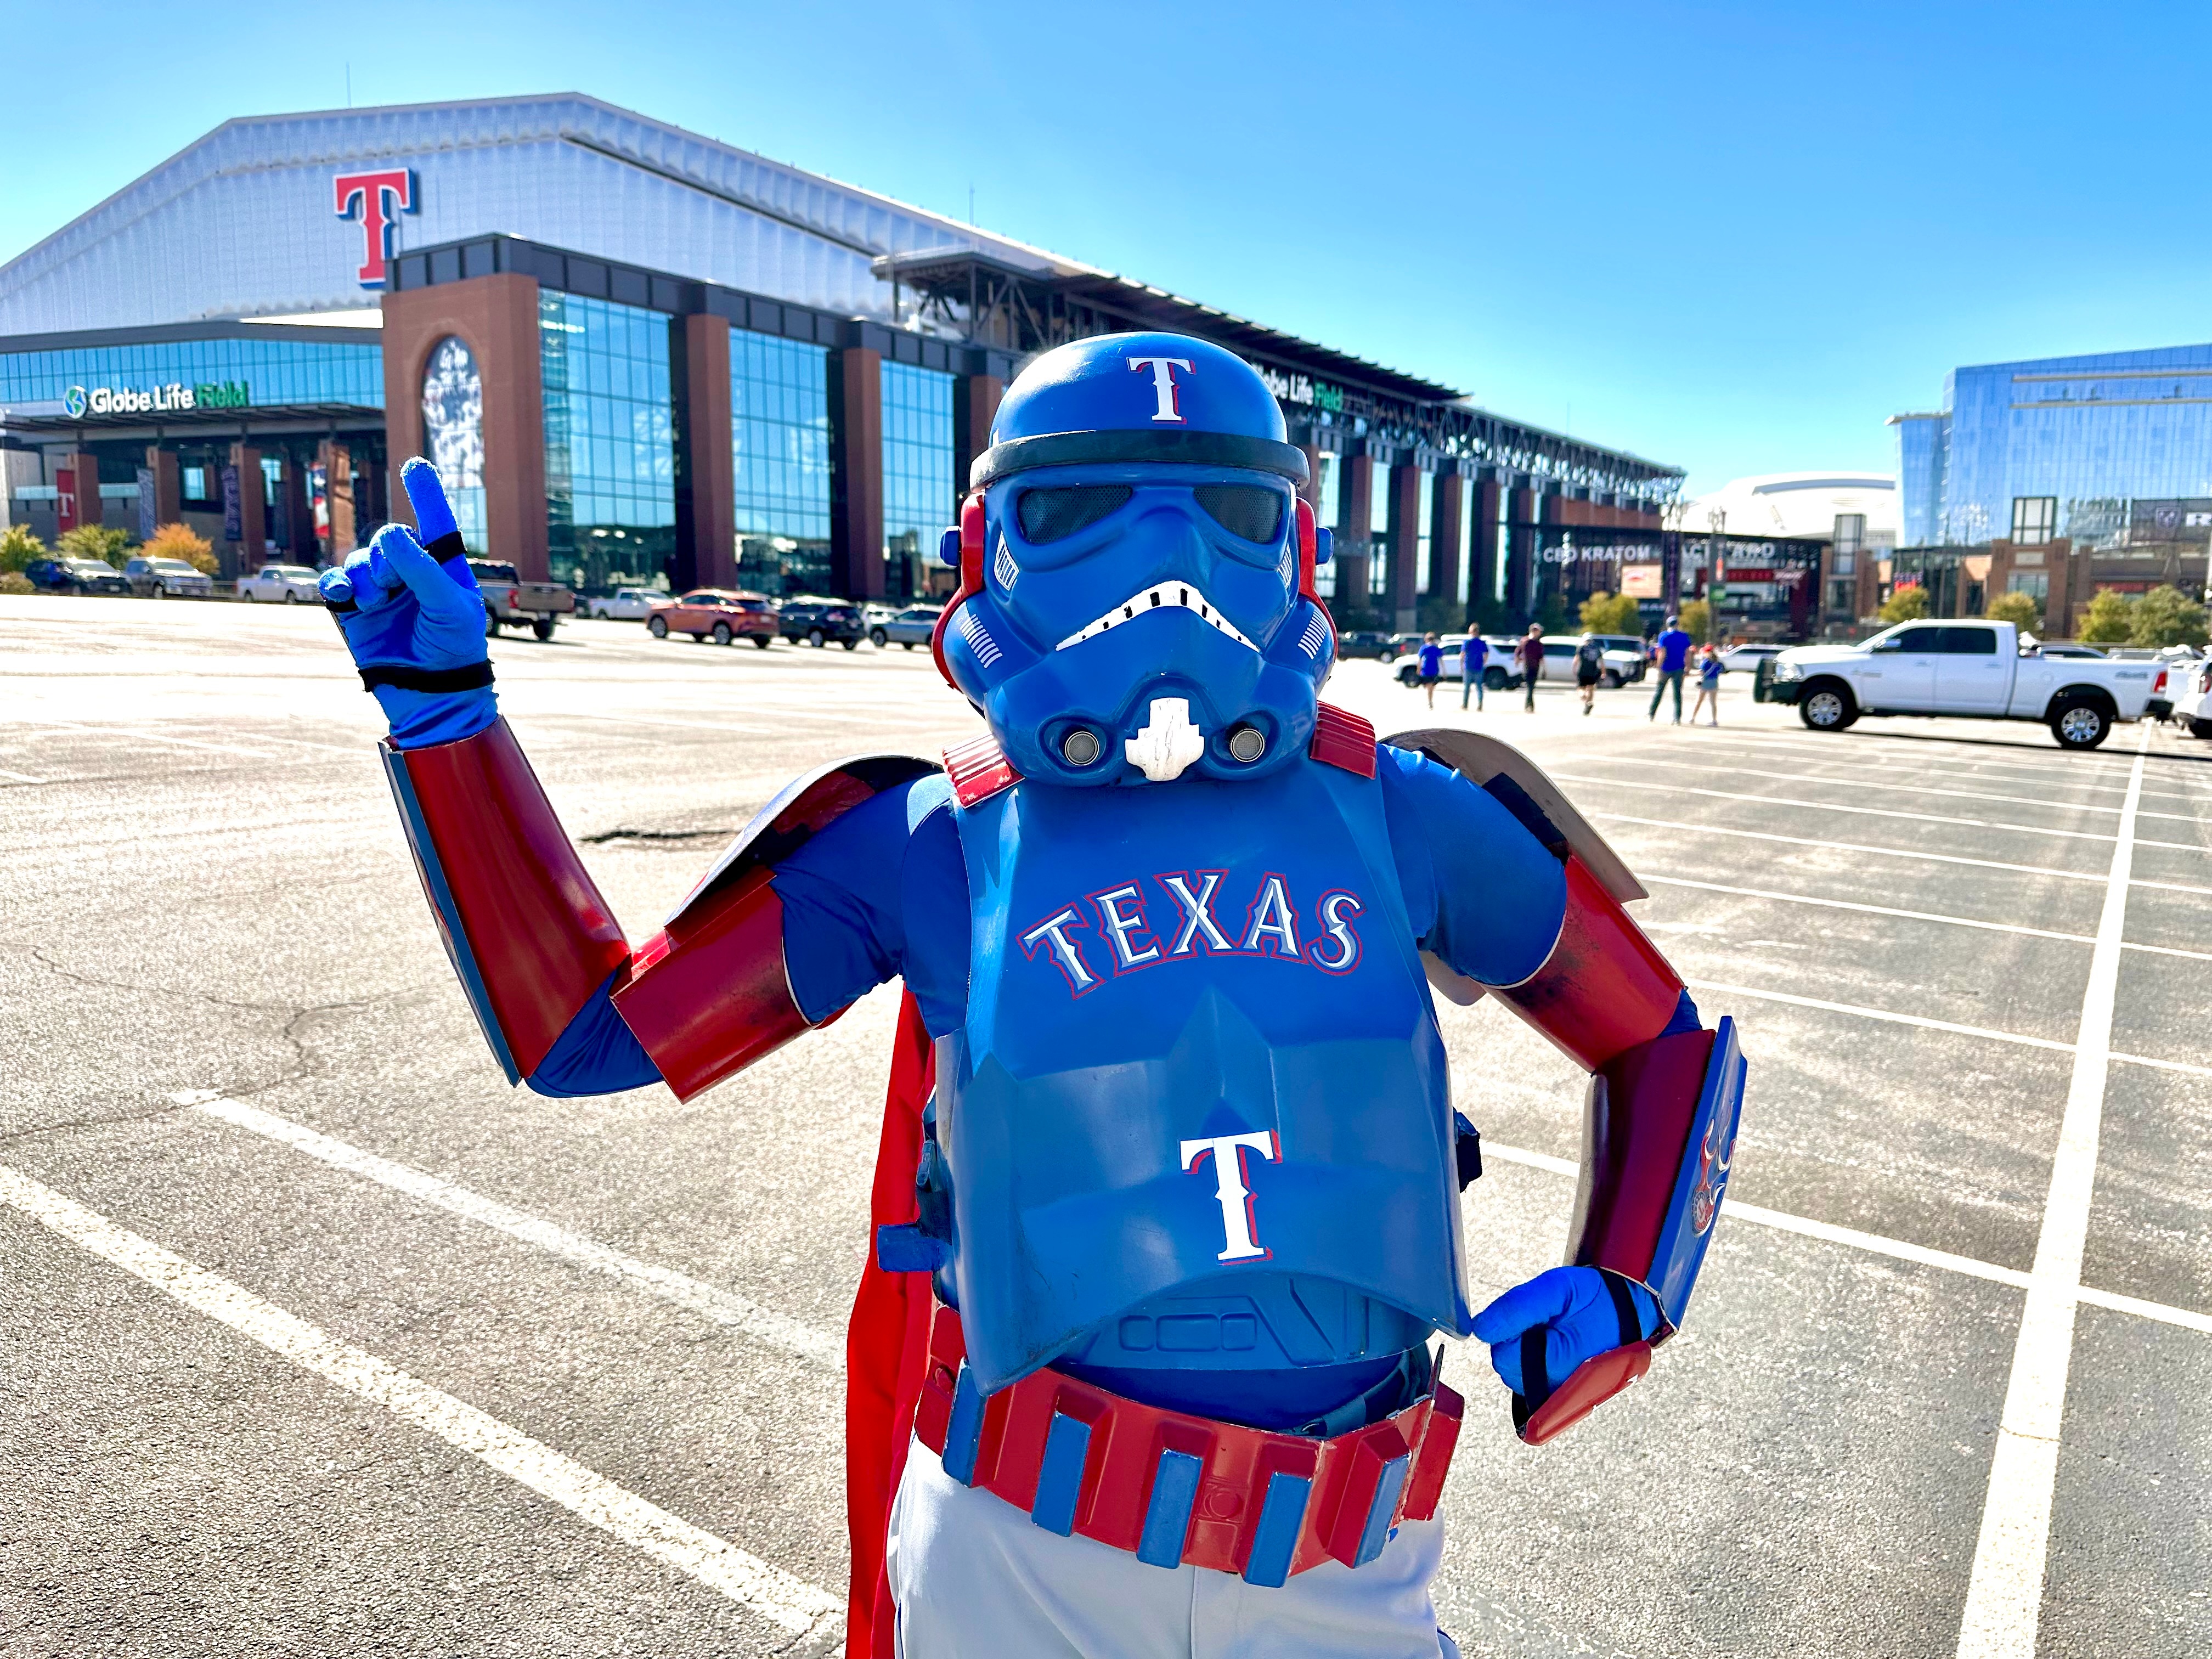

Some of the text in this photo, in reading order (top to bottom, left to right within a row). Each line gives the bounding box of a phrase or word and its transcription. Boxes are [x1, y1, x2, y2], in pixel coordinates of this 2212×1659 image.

[332, 167, 415, 290] T
[91, 380, 250, 413] Globe Life Field
[1127, 357, 1196, 425] T
[1290, 373, 1314, 406] Life
[1314, 382, 1343, 412] Field
[58, 493, 75, 517] T
[1015, 868, 1367, 1001] TEXAS
[1177, 1127, 1284, 1266] T
